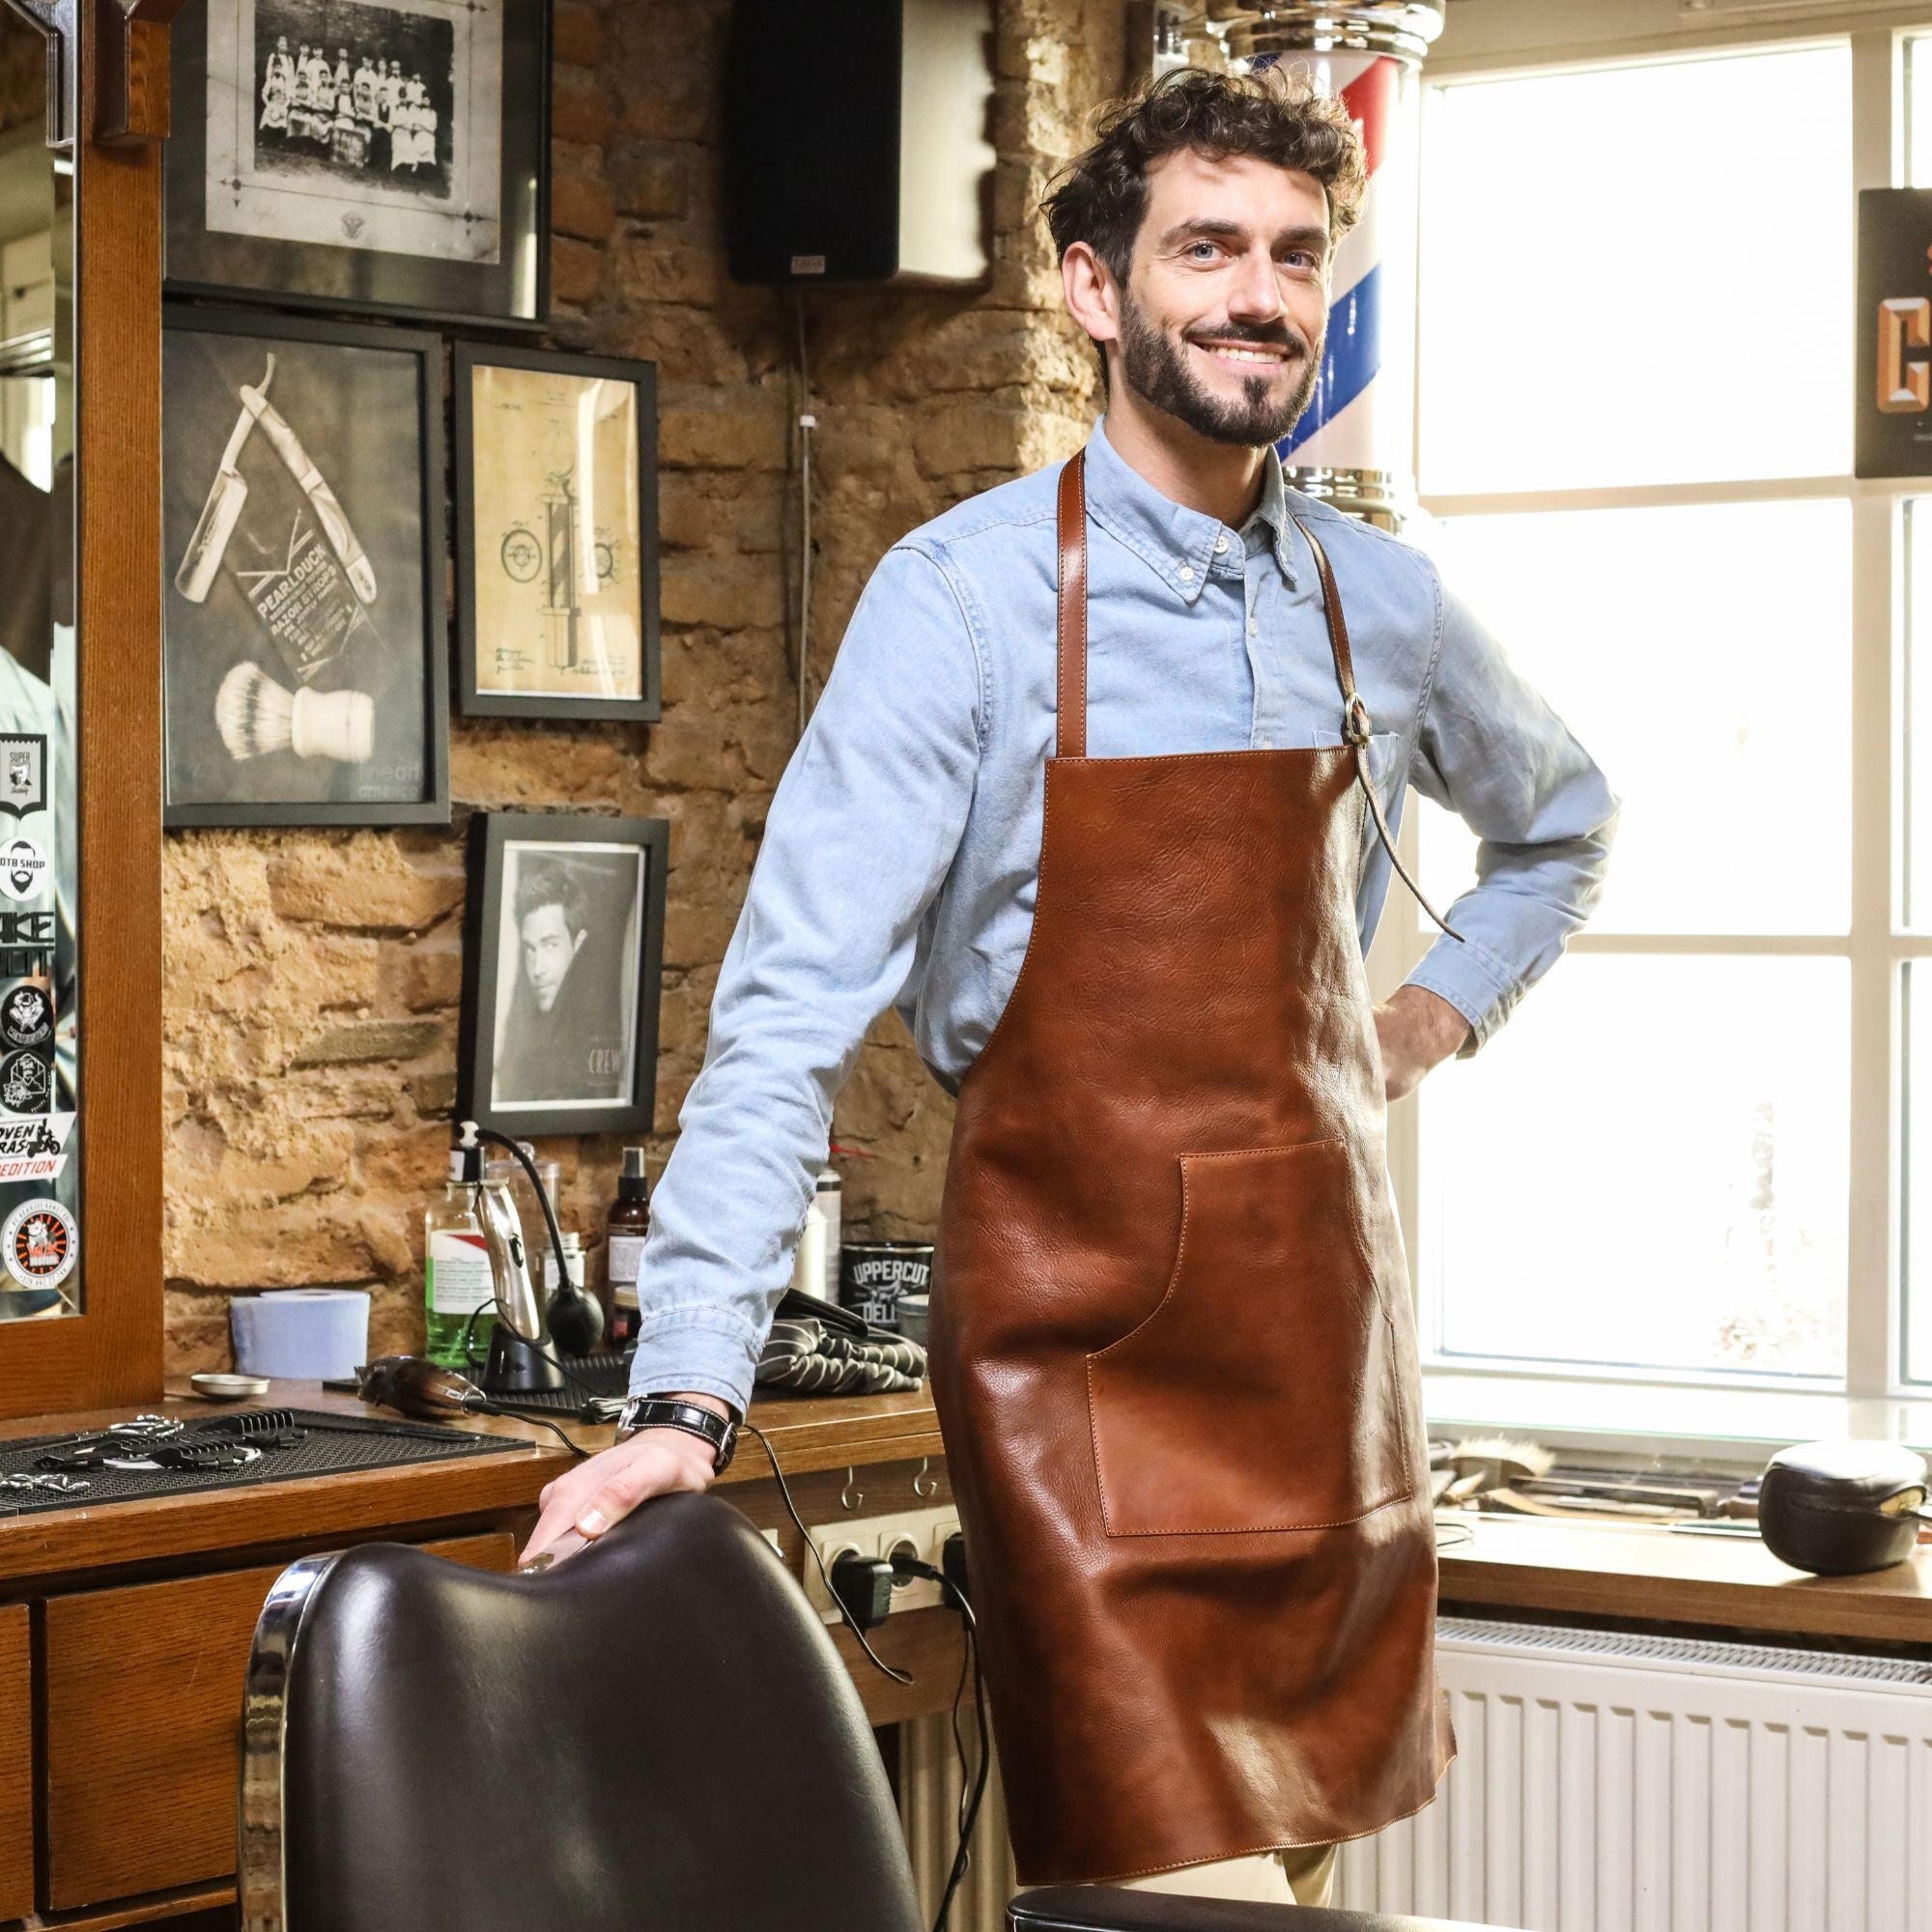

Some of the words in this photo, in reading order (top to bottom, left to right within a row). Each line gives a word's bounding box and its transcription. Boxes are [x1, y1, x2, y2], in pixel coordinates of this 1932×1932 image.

[257, 544, 326, 618] PEARLDUCK
[270, 602, 302, 636] RAZOR
[10, 752, 30, 762] SUPER
[19, 859, 45, 869] SHOP
[588, 1049, 622, 1074] CREW
[0, 1160, 56, 1177] EDITION
[853, 1260, 929, 1286] UPPERCUT
